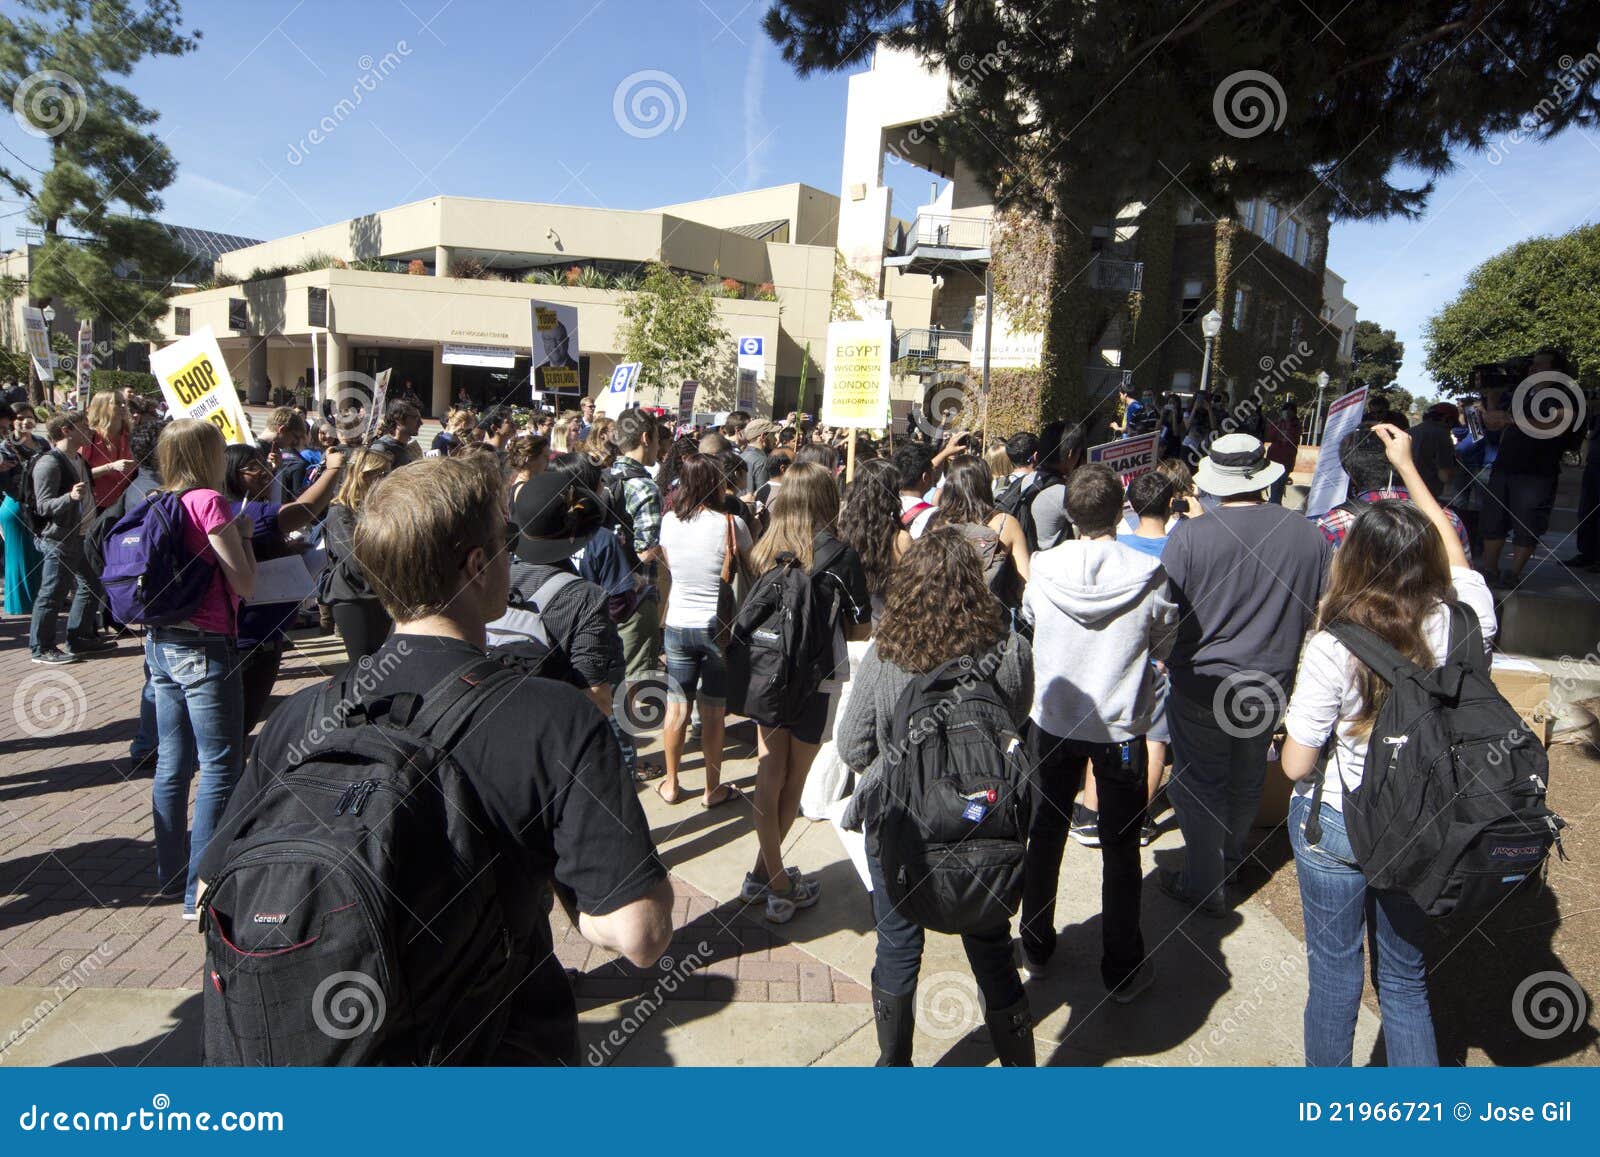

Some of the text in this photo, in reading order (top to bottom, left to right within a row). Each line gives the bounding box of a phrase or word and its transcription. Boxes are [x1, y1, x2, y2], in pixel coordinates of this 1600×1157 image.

[836, 345, 881, 357] EGYPT
[834, 364, 881, 372] WISCONSIN
[173, 360, 216, 405] CHOP
[834, 380, 879, 390] LONDON
